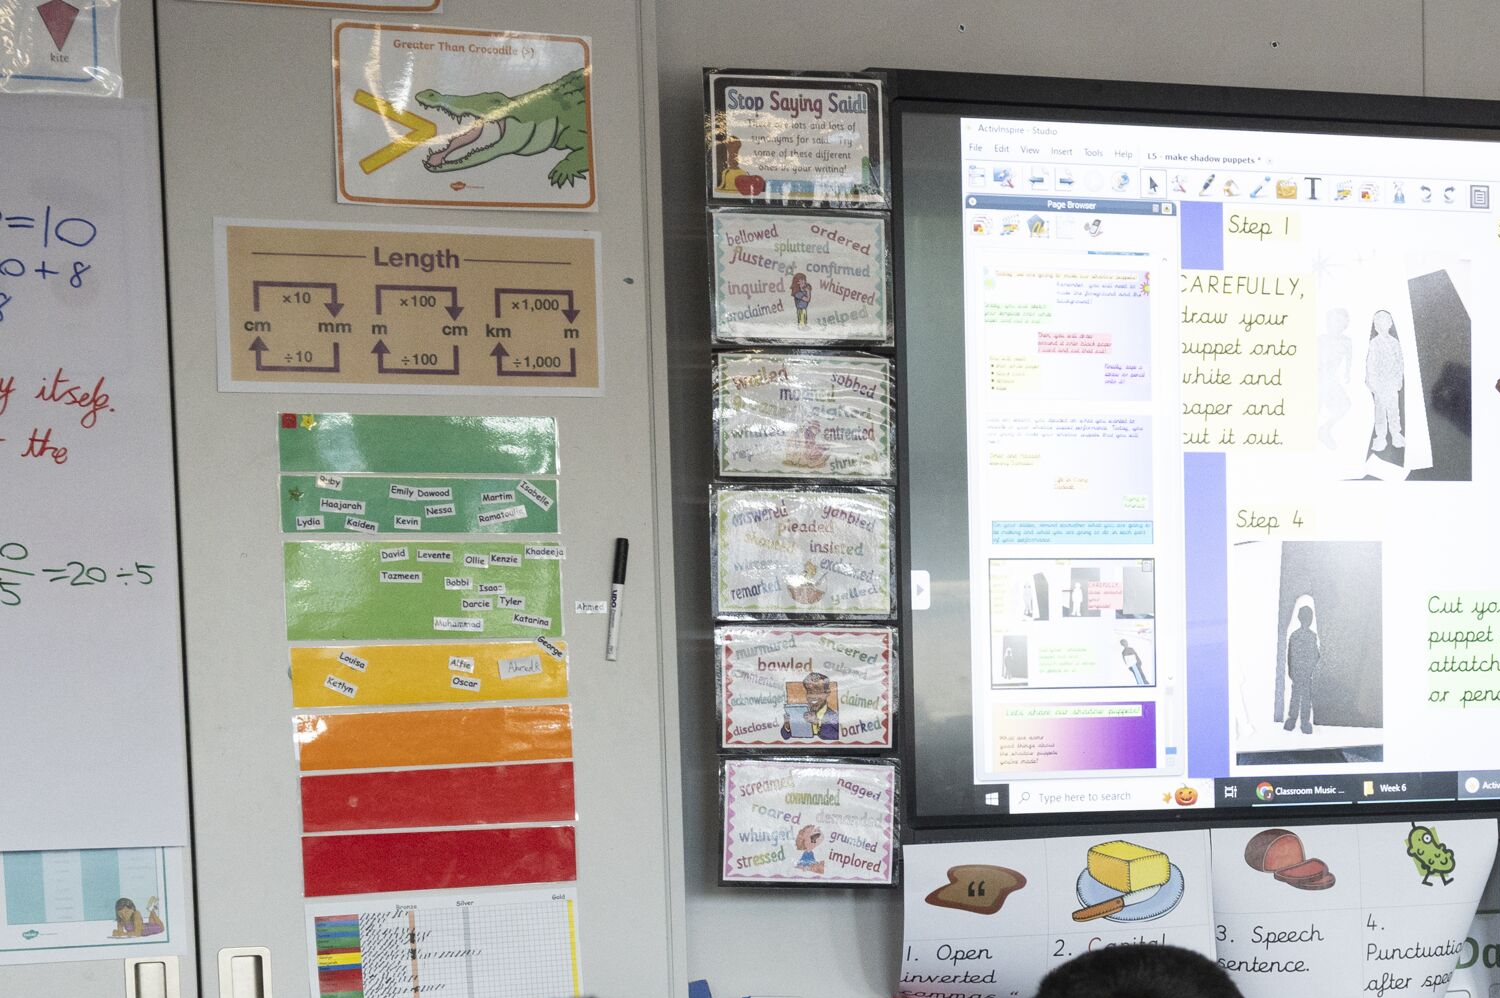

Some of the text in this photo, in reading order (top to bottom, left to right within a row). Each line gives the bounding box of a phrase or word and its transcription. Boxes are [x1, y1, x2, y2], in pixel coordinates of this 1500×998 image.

[393, 39, 518, 56] Greater Than Crocodile
[50, 52, 69, 64] kite
[727, 89, 867, 119] Stop Saying Said!
[815, 150, 851, 160] different
[969, 143, 1133, 159] File Edit View Insert Help
[1164, 154, 1256, 164] make shadow puppets
[1048, 200, 1096, 210] Page Browser
[726, 225, 779, 246] bellowed
[1228, 215, 1272, 241] Step
[810, 224, 870, 255] ordered
[374, 246, 460, 272] Length
[806, 261, 870, 277] confirmed
[727, 278, 785, 297] inquired
[819, 278, 875, 306] whispered
[244, 321, 579, 338] cm mm m cm km m
[1239, 313, 1288, 332] your
[1250, 339, 1296, 355] onto
[1240, 368, 1282, 385] and
[831, 372, 877, 399] sobbed
[1243, 398, 1285, 415] and
[1219, 428, 1283, 445] it out.
[21, 428, 68, 464] the
[391, 486, 414, 497] Emily
[418, 489, 450, 497] Dawood
[482, 493, 513, 502] Martim
[520, 481, 549, 506] Isabelle
[321, 500, 362, 510] Haajarah
[426, 507, 453, 515] Nessa
[297, 518, 320, 527] Lydia
[347, 519, 375, 531] Kaiden
[396, 517, 418, 525] Kevin
[1236, 509, 1304, 534] Step 4
[382, 549, 405, 559] David
[417, 552, 451, 560] Levente
[465, 556, 485, 565] Ollie
[491, 554, 518, 563] Kenzie
[382, 572, 420, 580] Tazmeen
[462, 600, 490, 608] Darcie
[500, 597, 522, 605] Tyler
[1428, 596, 1463, 613] Cut
[513, 614, 549, 626] Katarina
[1427, 625, 1493, 649] puppet
[537, 635, 563, 658] George
[340, 652, 365, 669] Louisa
[758, 657, 812, 672] bawled
[326, 676, 354, 694] Ketlyn
[452, 677, 478, 688] Oscar
[1428, 690, 1449, 702] or
[733, 718, 779, 736] disclosed
[841, 717, 881, 737] barked
[837, 777, 881, 801] nagged
[1275, 786, 1336, 796] Classroom Music
[1380, 784, 1400, 792] Week
[1038, 791, 1131, 804] Type here to search
[751, 803, 800, 824] roared
[830, 830, 877, 852] grumbled
[736, 847, 785, 869] stressed
[828, 849, 881, 872] implored
[1367, 913, 1384, 930] 4.
[1216, 924, 1324, 950] 3. Speech
[907, 944, 992, 966] 1. Open
[1053, 939, 1072, 957] 2.
[900, 970, 997, 984] inverted
[1364, 972, 1412, 998] after
